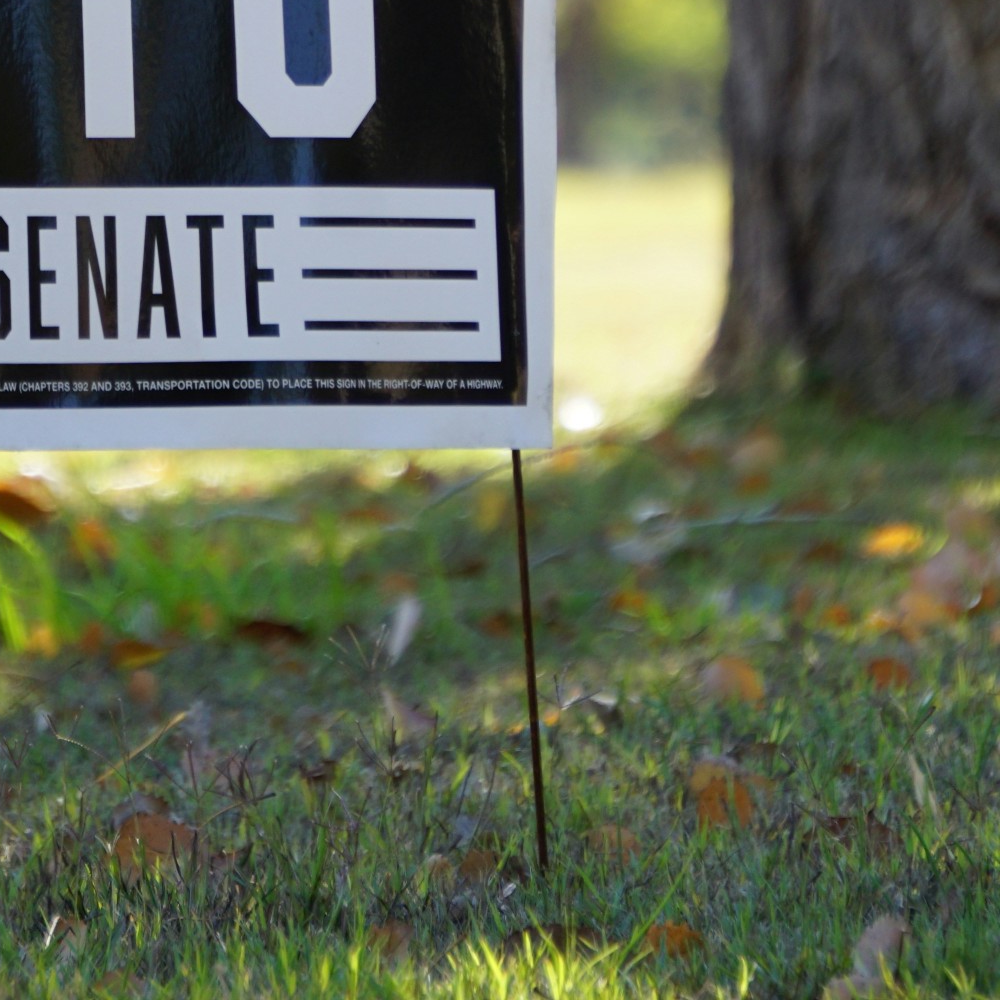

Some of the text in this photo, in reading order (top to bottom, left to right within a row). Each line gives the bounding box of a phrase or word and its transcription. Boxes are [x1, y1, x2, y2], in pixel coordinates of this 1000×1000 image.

[72, 381, 89, 392] 392
[91, 381, 112, 392] AND
[136, 380, 230, 391] TRANSPORTATION
[267, 379, 280, 390] TO
[282, 379, 313, 390] PLACE
[315, 379, 335, 389] THIS
[337, 379, 357, 389] SIGN
[358, 379, 366, 389] IN
[368, 379, 382, 389] THE
[384, 379, 445, 389] RIGHT-OF-WAY
[446, 379, 458, 389] OF
[459, 379, 466, 389] A
